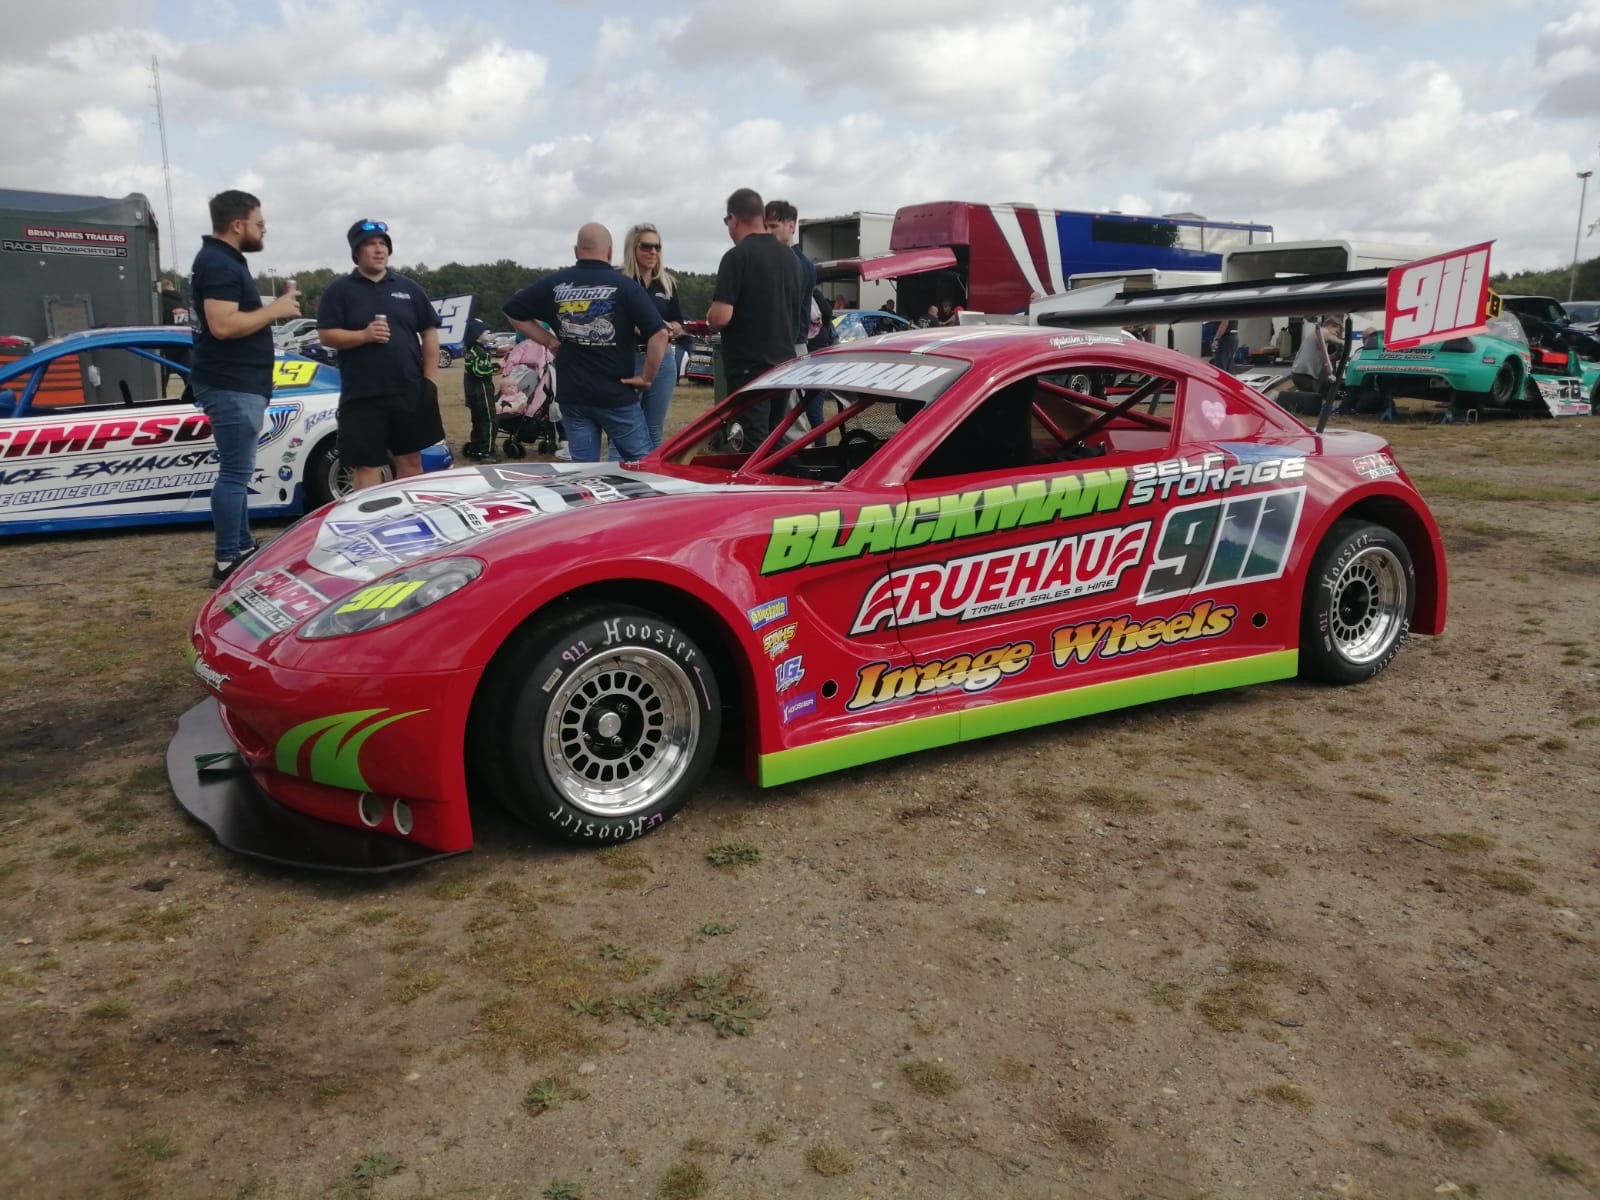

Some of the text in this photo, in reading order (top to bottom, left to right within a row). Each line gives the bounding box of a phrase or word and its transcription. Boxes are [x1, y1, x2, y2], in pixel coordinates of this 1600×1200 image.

[3, 241, 41, 252] RACE
[43, 245, 116, 256] TRANSPORTER
[27, 229, 125, 242] BRIAN JAMES TRAILERS
[1389, 248, 1490, 343] 911
[0, 415, 214, 458] IMPSO
[13, 485, 90, 505] CHOICE
[90, 481, 118, 496] OF
[119, 472, 220, 492] CHAMPION
[1129, 458, 1306, 506] STORAGE
[1133, 453, 1226, 482] SELF
[761, 468, 1132, 575] BLACKMAN
[1137, 485, 1307, 607] 911
[335, 580, 427, 614] 911
[849, 521, 1153, 638] FRUEHAUF
[970, 598, 1026, 616] TRAILER
[1028, 589, 1072, 605] SALES
[1086, 578, 1116, 592] HIRE
[561, 640, 593, 663] 911
[602, 617, 696, 662] Hoosier
[847, 600, 1237, 711] Image Wheels
